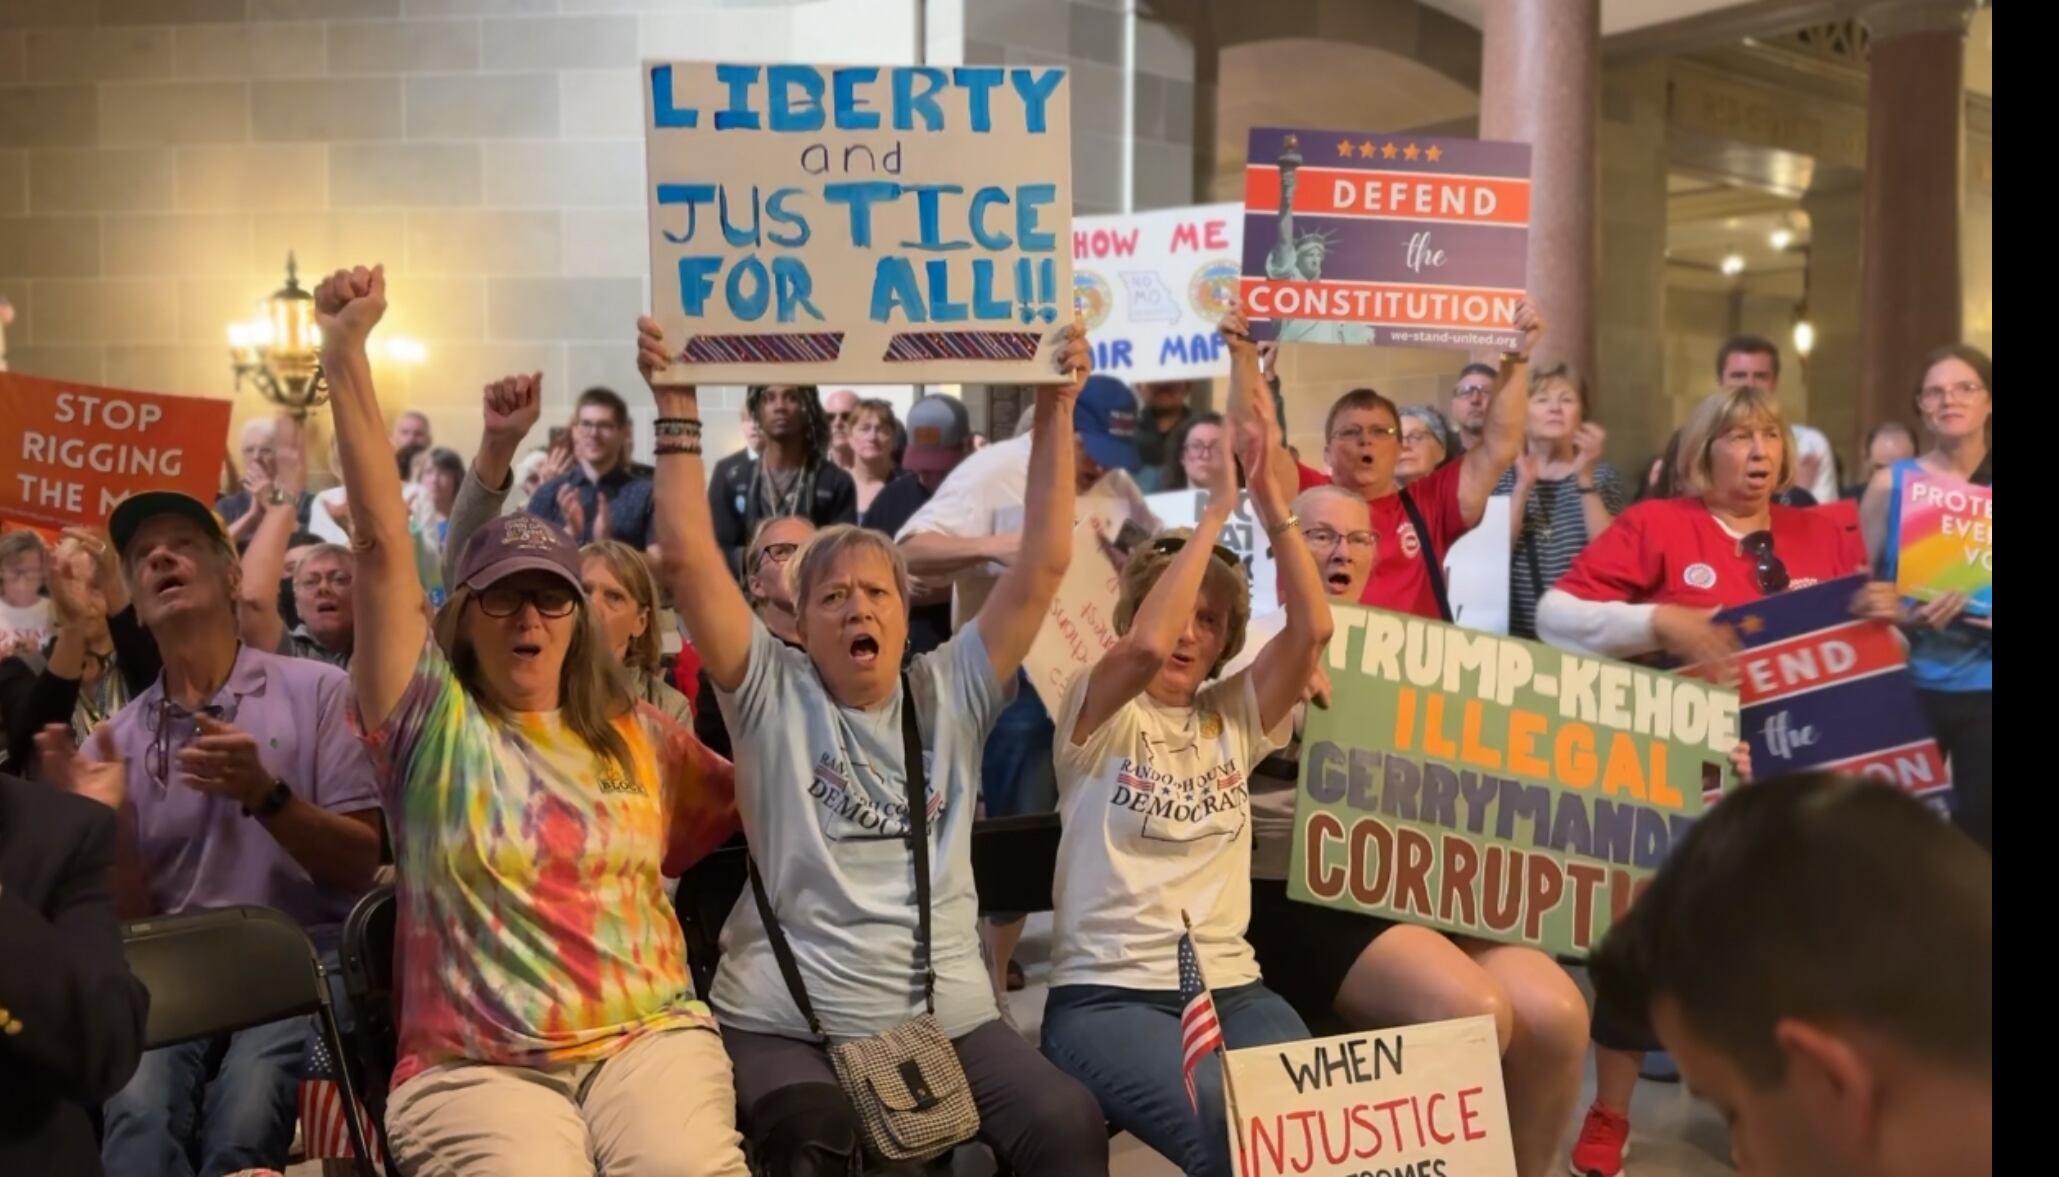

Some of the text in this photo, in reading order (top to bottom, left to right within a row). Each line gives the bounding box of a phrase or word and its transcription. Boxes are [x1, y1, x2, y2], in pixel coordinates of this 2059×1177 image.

[650, 64, 1067, 133] LIBERTY
[800, 140, 902, 175] and
[657, 182, 1057, 251] JUSTICE
[1332, 179, 1497, 217] DEFEND
[1072, 219, 1230, 260] HOW ME
[1402, 231, 1447, 273] the
[677, 254, 1058, 325] FOR ALL!!
[1248, 285, 1516, 324] CONSTITUTION
[1390, 331, 1518, 348] we-stand-united.org
[55, 392, 162, 433] STOP
[22, 430, 183, 477] RIGGING
[17, 473, 84, 513] THE
[1911, 481, 1992, 520] PROTE
[1963, 545, 1992, 572] VO
[1328, 604, 1740, 753] TRUMP-KEHOE
[1746, 639, 1857, 693] END
[1394, 686, 1684, 808] ILLEGAL
[1757, 709, 1820, 760] the
[1305, 810, 1650, 950] CORRUPTI
[1279, 1035, 1403, 1094] WHEN
